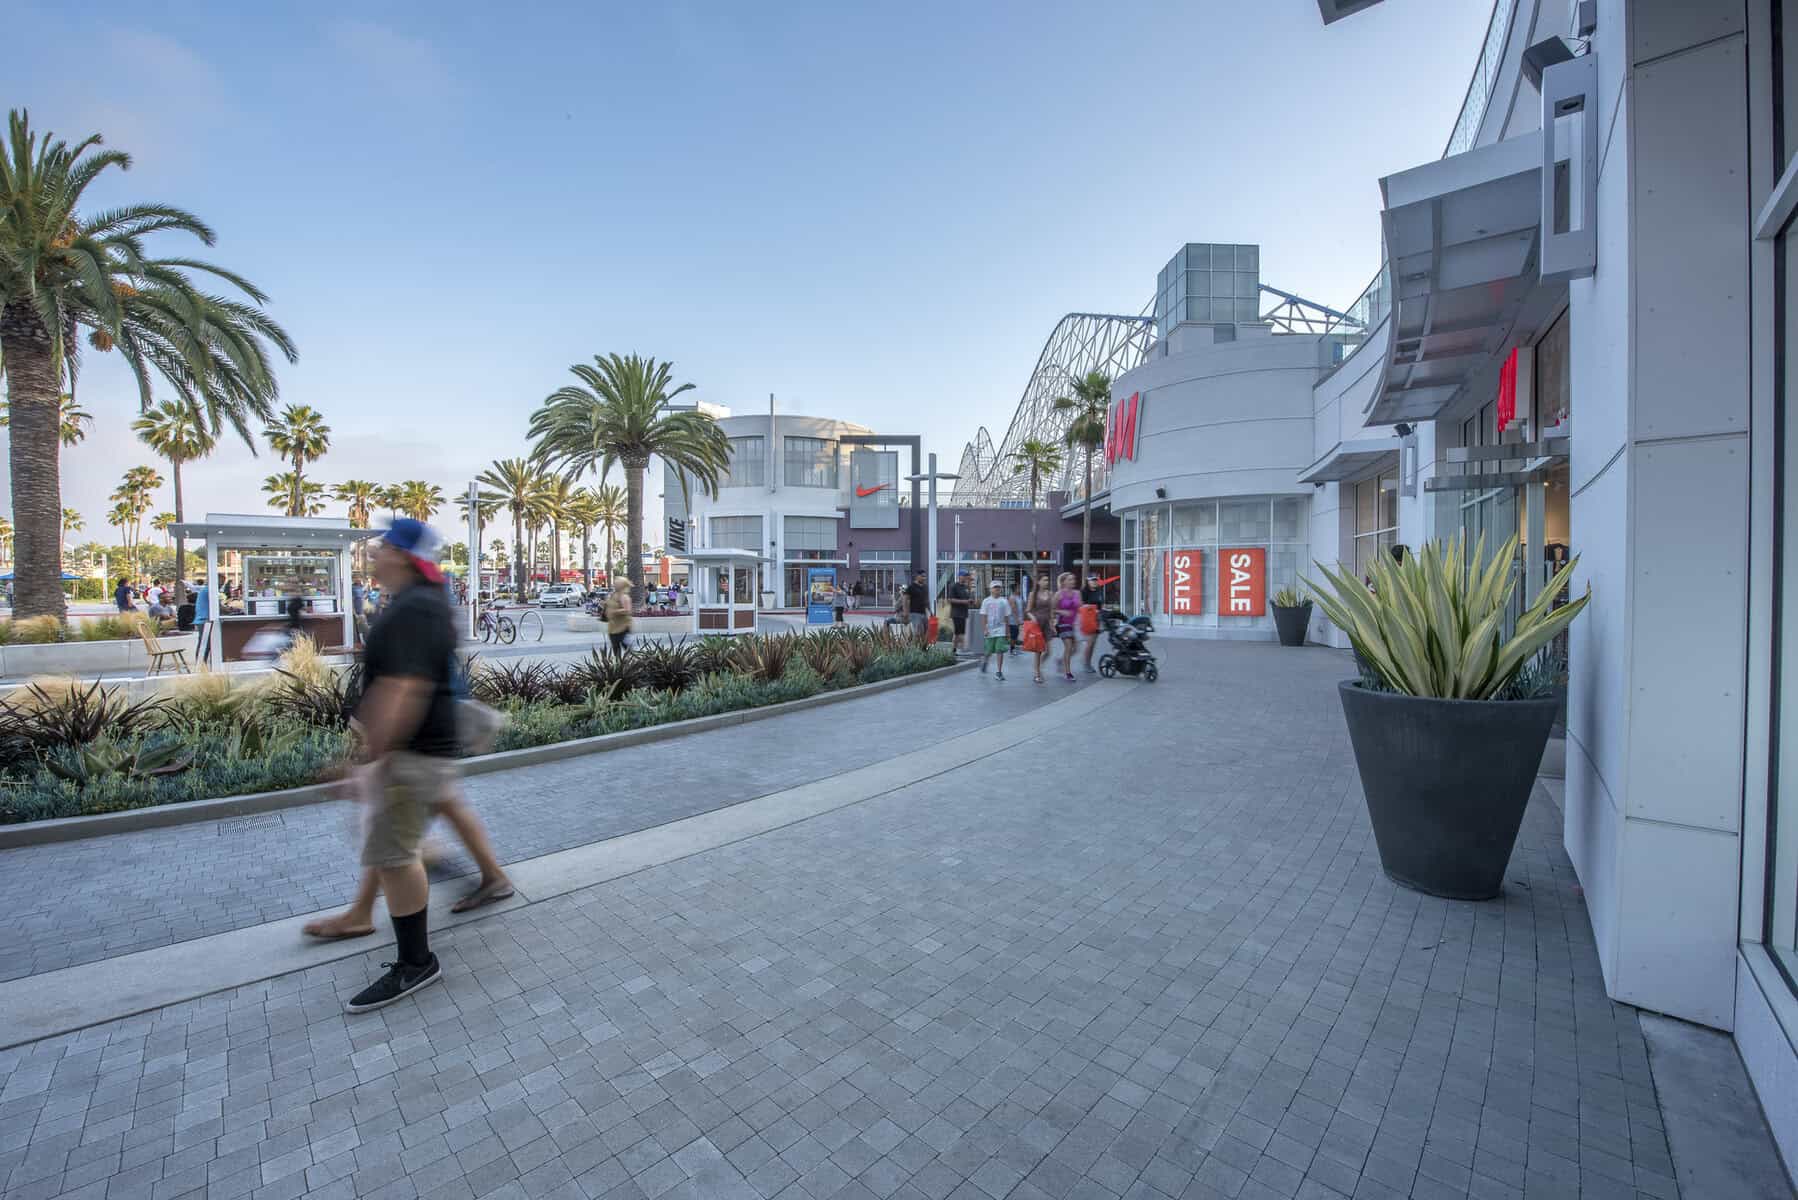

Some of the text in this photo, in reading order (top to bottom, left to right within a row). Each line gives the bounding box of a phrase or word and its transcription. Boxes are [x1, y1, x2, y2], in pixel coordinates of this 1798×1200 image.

[669, 516, 685, 552] NIKE
[1174, 555, 1191, 610] SALE
[1230, 554, 1251, 612] SALE
